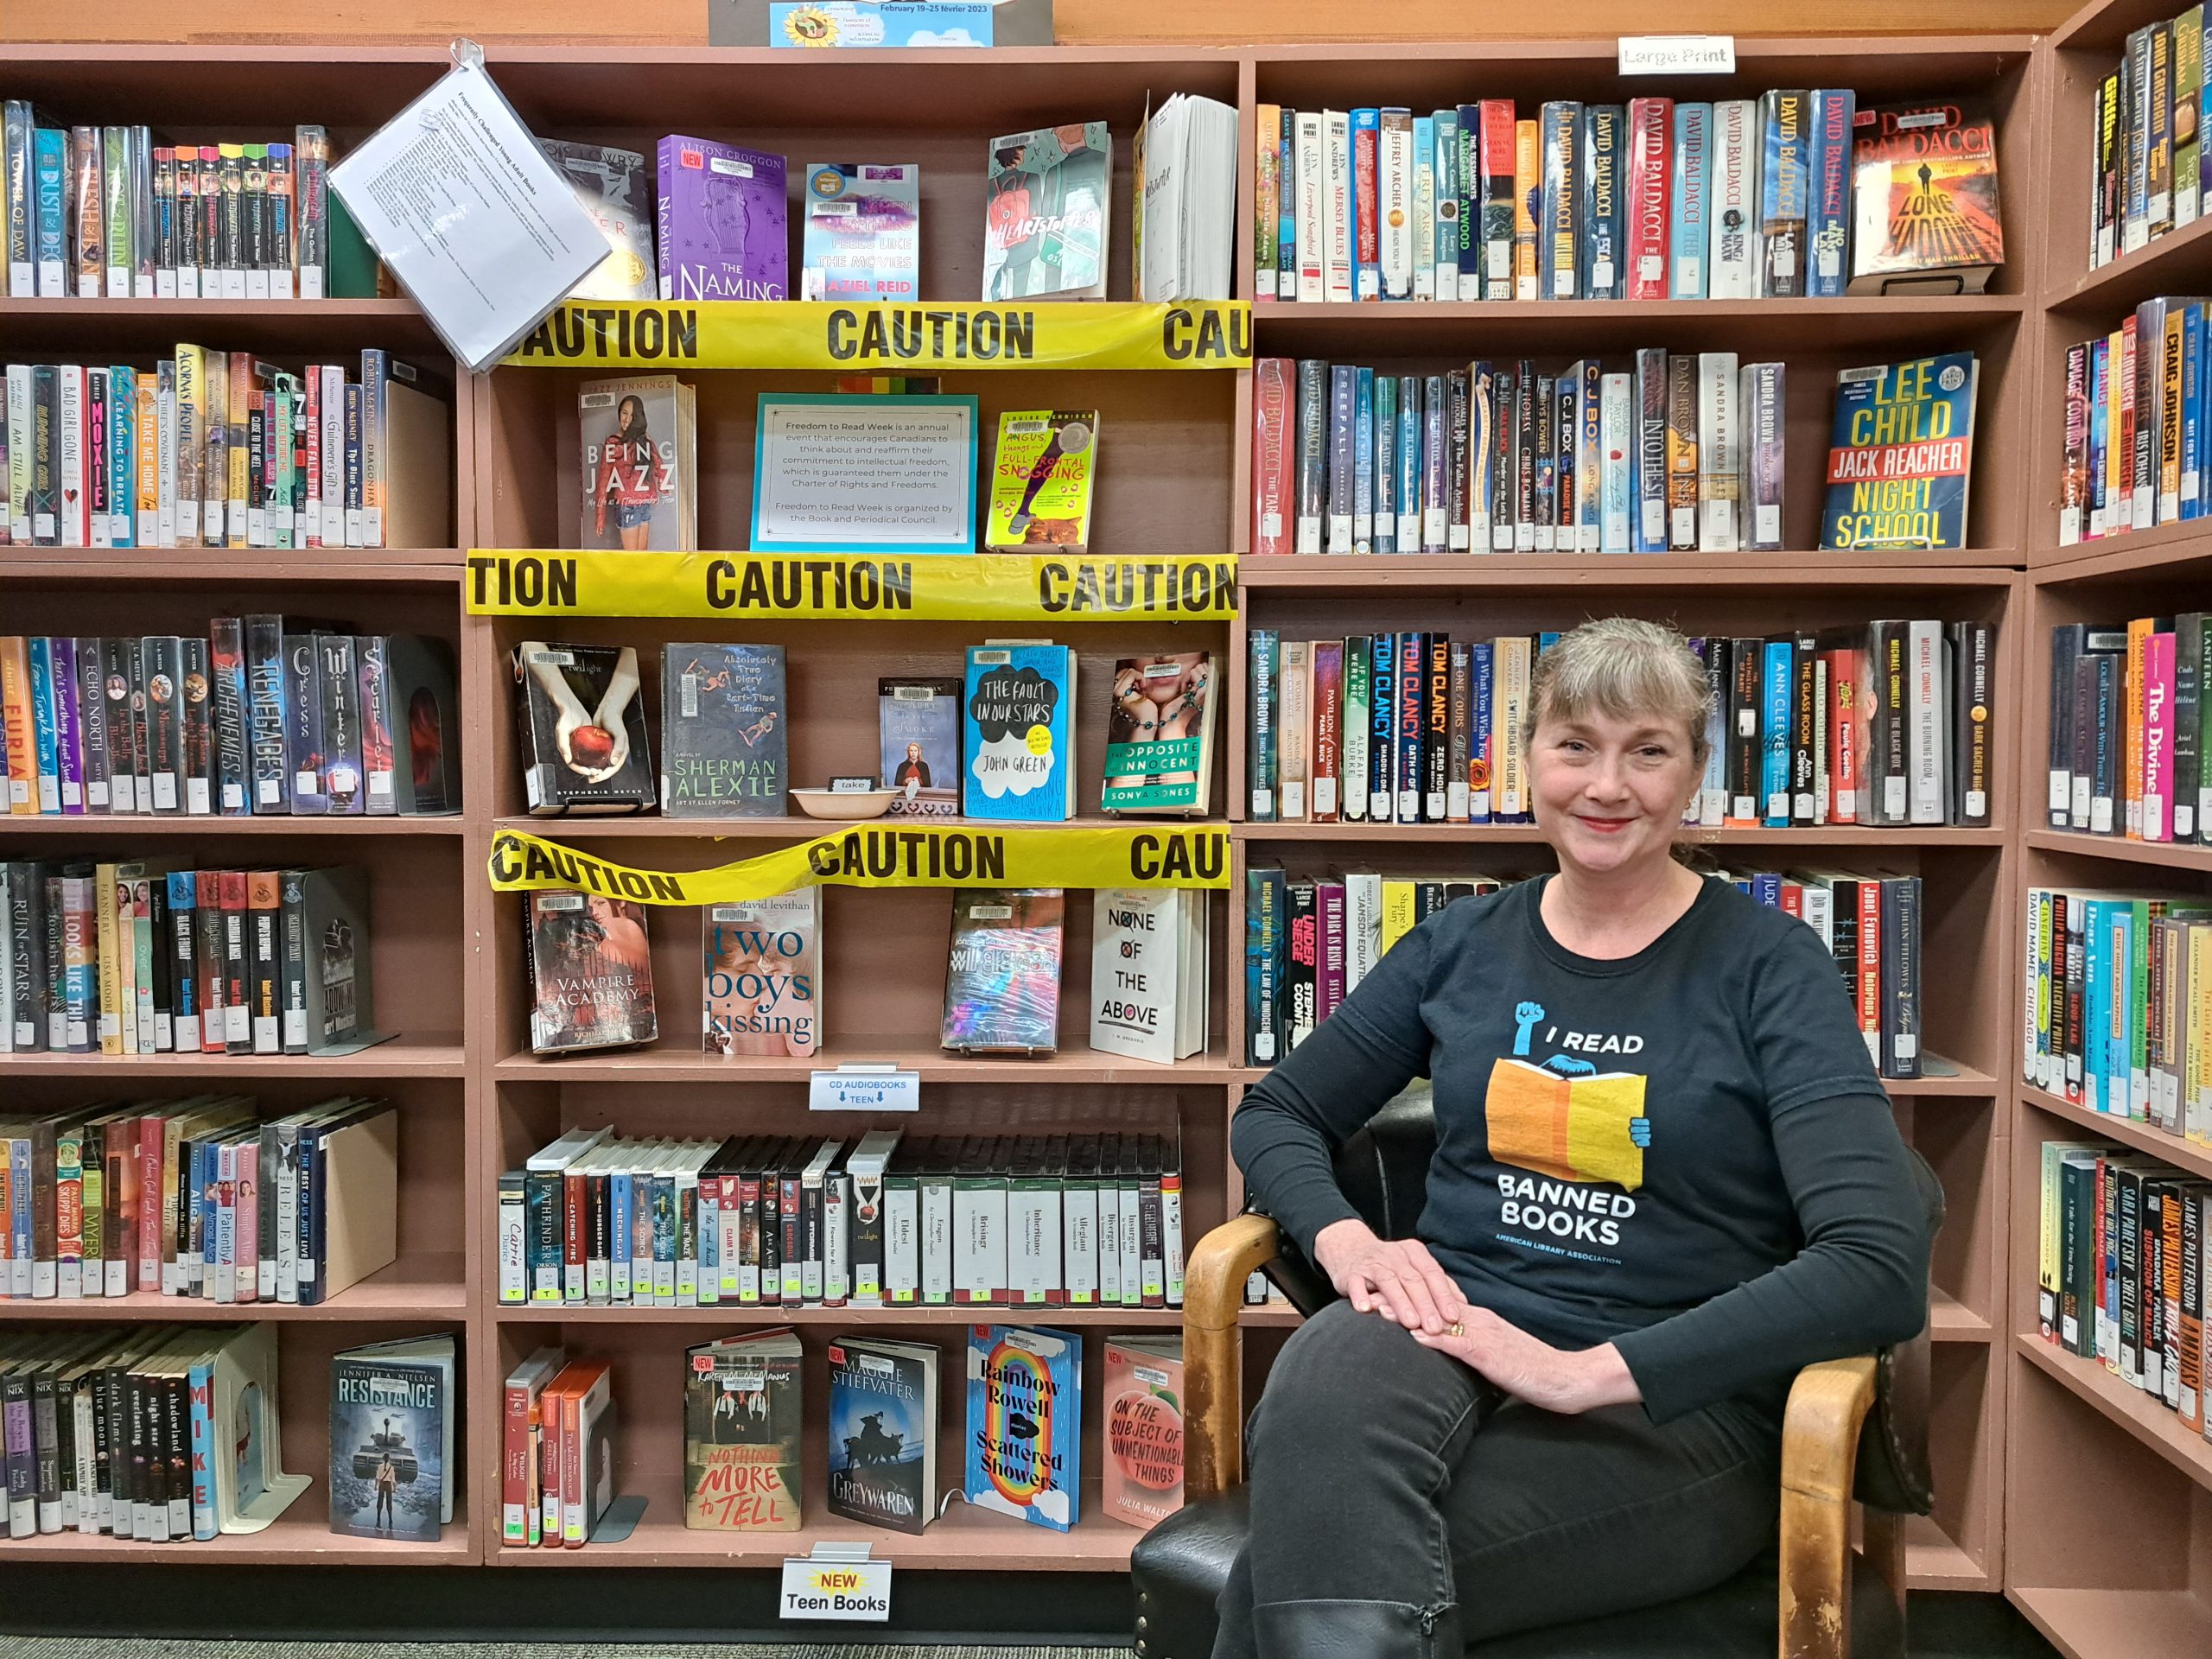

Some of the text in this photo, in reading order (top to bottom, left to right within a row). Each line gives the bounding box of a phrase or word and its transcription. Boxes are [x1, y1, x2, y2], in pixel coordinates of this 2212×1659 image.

[880, 4, 914, 13] February
[1624, 48, 1727, 67] Large Print
[458, 92, 537, 196] Frequently Challenged Young Adult Books
[679, 142, 722, 156] ALISON
[727, 151, 781, 169] CROGGON
[1856, 129, 1990, 162] BALDACCI
[683, 154, 702, 167] NEW
[1643, 103, 1663, 241] DAVID BALDACCI
[658, 196, 671, 270] NAMING
[995, 210, 1096, 243] HEARTSTOPPER
[833, 238, 912, 249] FEELS LIKE
[721, 263, 743, 274] THE
[817, 257, 912, 269] THE MOVIES
[680, 264, 784, 301] NAMING
[876, 281, 911, 293] REID
[505, 308, 696, 359] AUTION
[828, 309, 1033, 359] CAUTION
[1875, 360, 1936, 405] LEE
[2164, 333, 2179, 462] CRAIG JOHNSON
[1851, 401, 1952, 447] CHILD
[92, 402, 103, 507] MOXIE
[588, 441, 672, 464] BEING
[857, 457, 906, 466] intellectual
[909, 458, 950, 467] freedom,
[1002, 454, 1084, 467] FULL-FRONTAL
[1834, 442, 1962, 479] JACK REACHER
[586, 464, 675, 494] JAZZ
[822, 469, 874, 478] guaranteed
[933, 469, 949, 478] the
[840, 480, 868, 489] Rights
[891, 480, 938, 489] Freedoms.
[999, 464, 1084, 480] SNOGGING
[775, 502, 817, 511] Freedom
[831, 503, 854, 512] Read
[886, 504, 893, 512] is
[894, 505, 939, 513] organized
[942, 505, 953, 513] by
[1853, 477, 1936, 513] NIGHT
[808, 514, 831, 523] Book
[854, 515, 899, 524] Periodical
[1835, 512, 1946, 548] SCHOOL
[468, 558, 1238, 613] TION CAUTION CAUTION
[569, 658, 601, 673] twilight
[1891, 639, 1900, 709] MICHAEL CONNELLY
[983, 680, 1046, 700] THE FAULT
[1374, 639, 1391, 739] TOM CLANCY
[1402, 640, 1420, 741] TOM CLANCY
[2149, 683, 2164, 722] The
[86, 665, 103, 751] ECHO NORTH
[977, 703, 1050, 723] IN OUR STARS
[1774, 664, 1785, 757] ANN CLEEVES
[5, 704, 25, 779] FURIA
[1125, 741, 1198, 758] OPPOSITE
[674, 760, 776, 776] SHERMAN
[983, 755, 1046, 772] JOHN GREEN
[1120, 756, 1198, 772] INNOCENT
[676, 776, 777, 798] ALEXIE
[1111, 787, 1190, 800] SONYA SONES
[494, 832, 1231, 901] CAUTION CAUTION CAU
[740, 900, 810, 910] david levithan
[1109, 909, 1155, 931] NONE
[714, 925, 804, 957] two
[1120, 940, 1142, 959] OF
[557, 975, 635, 991] VAMPIRE
[709, 954, 811, 1014] boys
[1116, 970, 1147, 992] THE
[556, 988, 639, 1006] ACADEMY
[704, 1001, 813, 1045] kissing
[1101, 1000, 1159, 1026] ABOVE
[1546, 1027, 1643, 1054] I READ
[1497, 1173, 1637, 1218] BANNED
[541, 1185, 552, 1260] PATHFINDER
[1033, 1209, 1042, 1257] Inheritance
[1501, 1200, 1621, 1246] BOOKS
[1496, 1233, 1622, 1265] AMERICAN LIBRARY ASSOCIATION
[696, 1357, 711, 1370] NEW
[981, 1358, 1061, 1396] Rainbow
[832, 1372, 915, 1401] STIEFVATER
[988, 1384, 1049, 1418] Rowell
[1115, 1399, 1160, 1423] ON THE
[1110, 1420, 1183, 1445] SUBJECT OF
[977, 1430, 1062, 1471] Scattered
[1112, 1440, 1184, 1466] UNMENTIONABL
[698, 1465, 781, 1496] MORE
[981, 1453, 1058, 1491] Showers
[1135, 1463, 1175, 1483] THINGS
[833, 1472, 914, 1516] GREYWAREN
[1116, 1495, 1140, 1510] JULIA
[698, 1491, 784, 1525] to TELL
[821, 1573, 857, 1588] NEW
[786, 1593, 887, 1611] Teen Books
